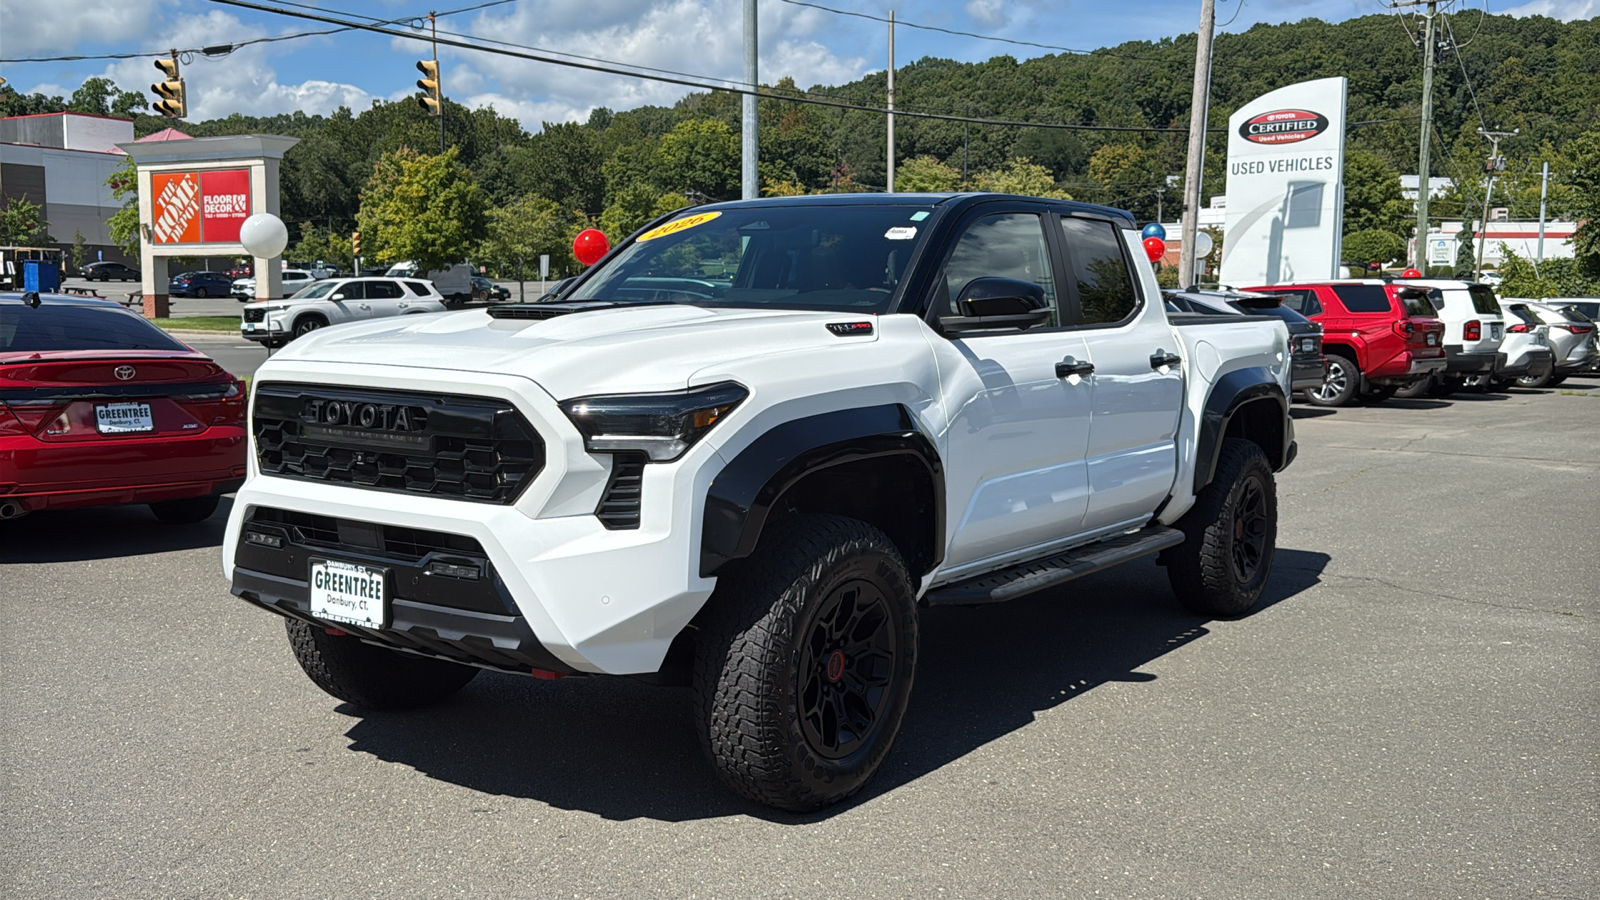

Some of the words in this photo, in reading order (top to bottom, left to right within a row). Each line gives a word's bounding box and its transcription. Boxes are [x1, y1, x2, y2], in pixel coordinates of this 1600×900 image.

[1249, 120, 1318, 134] CERTIFIED
[1231, 161, 1265, 176] USED
[1268, 156, 1333, 173] VEHICLES
[156, 178, 178, 208] THE
[203, 194, 232, 204] FLOOR
[154, 173, 199, 243] HOME
[204, 204, 232, 213] DECOR
[170, 197, 200, 243] DEPOT
[648, 215, 707, 238] 2026
[98, 407, 150, 420] GREENTREE
[311, 399, 412, 431] TOYOTA
[314, 570, 382, 600] GREENTREE
[326, 593, 357, 611] Danbury,
